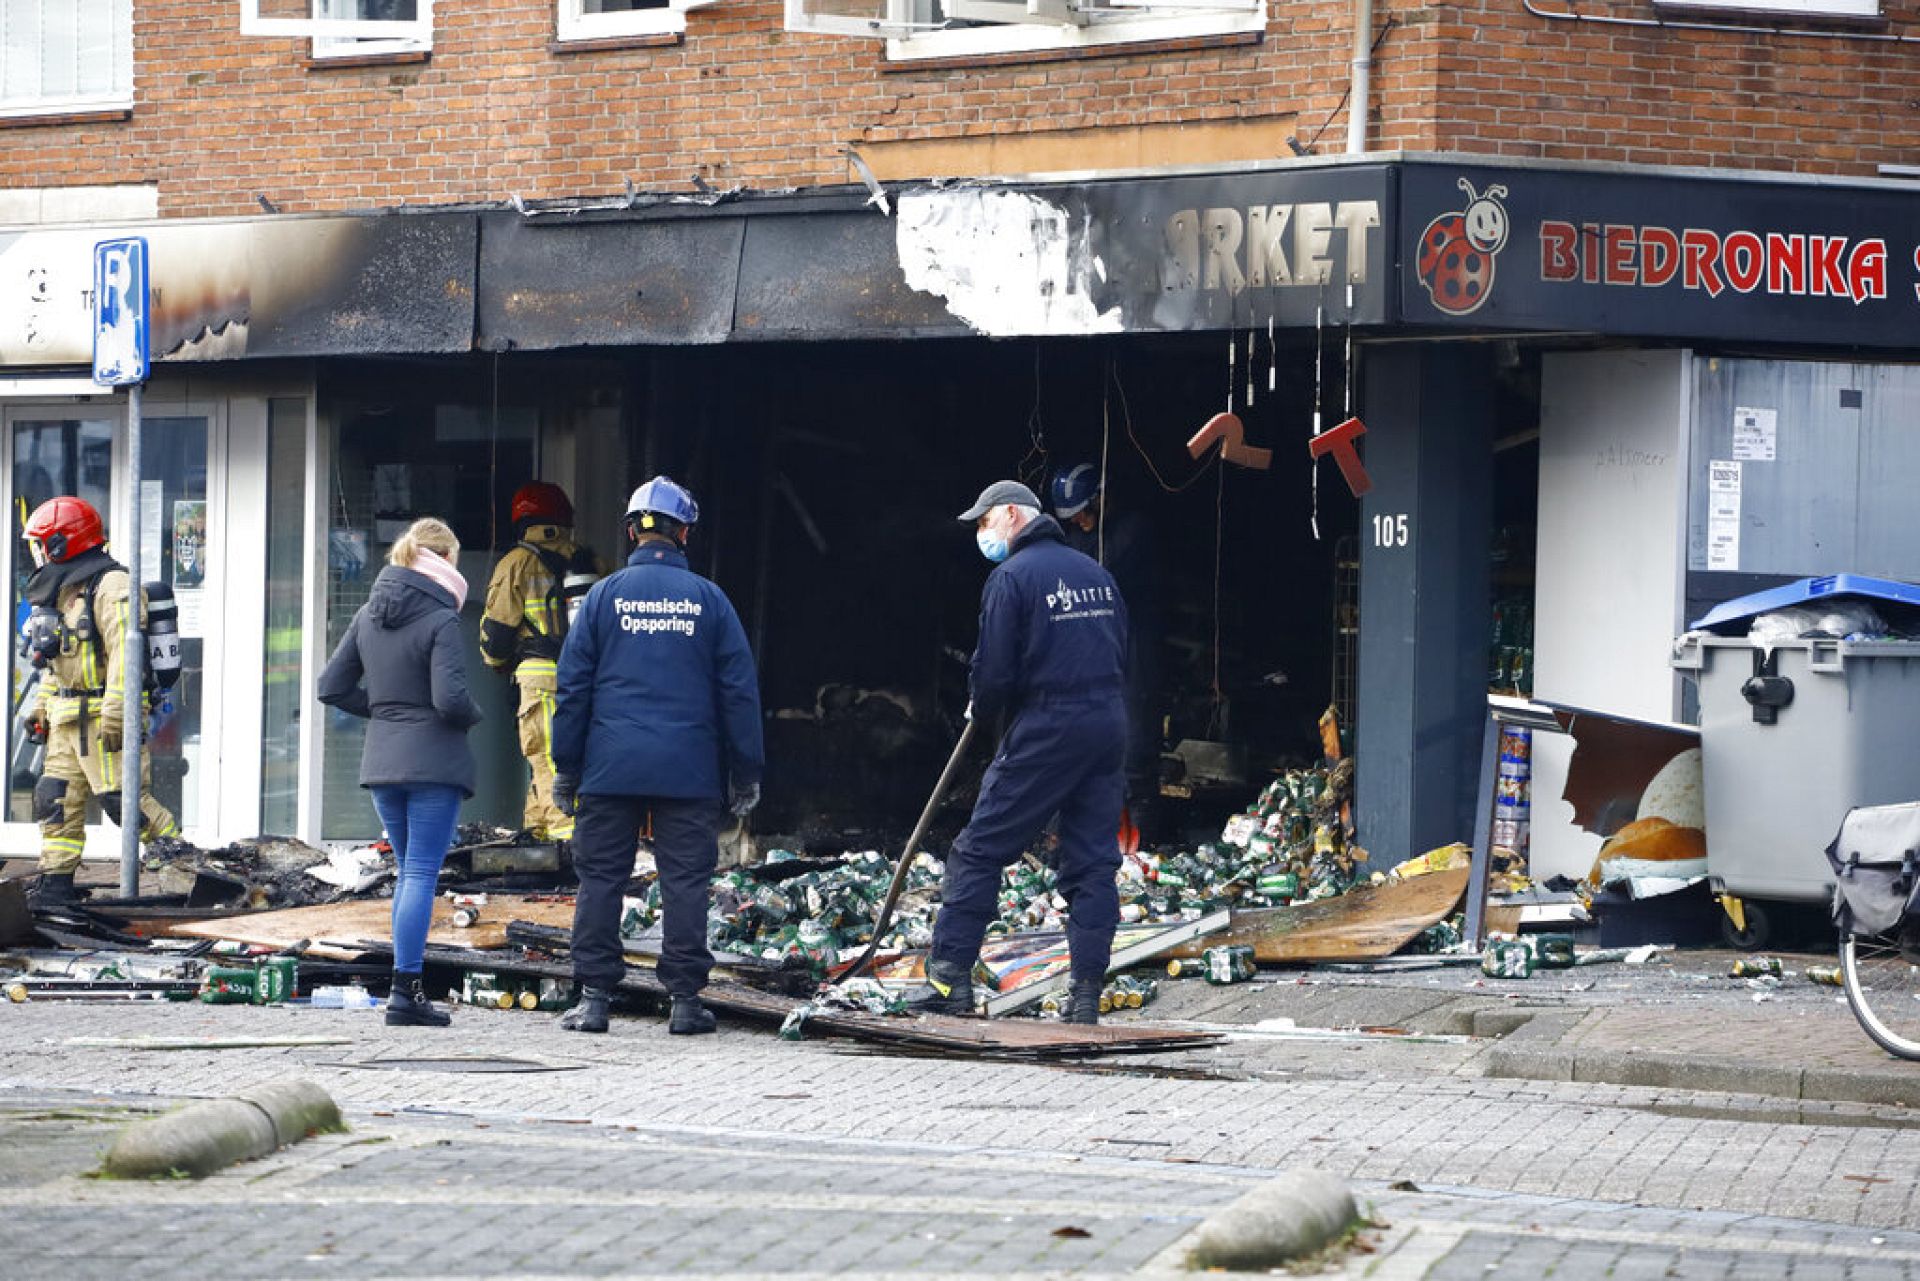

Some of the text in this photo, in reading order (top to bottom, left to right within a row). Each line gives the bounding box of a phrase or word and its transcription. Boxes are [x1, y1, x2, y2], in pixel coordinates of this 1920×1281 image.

[1539, 220, 1888, 305] BIEDRONKA
[1373, 514, 1408, 547] 105
[615, 598, 702, 615] Forensische
[621, 614, 695, 636] Opsporing
